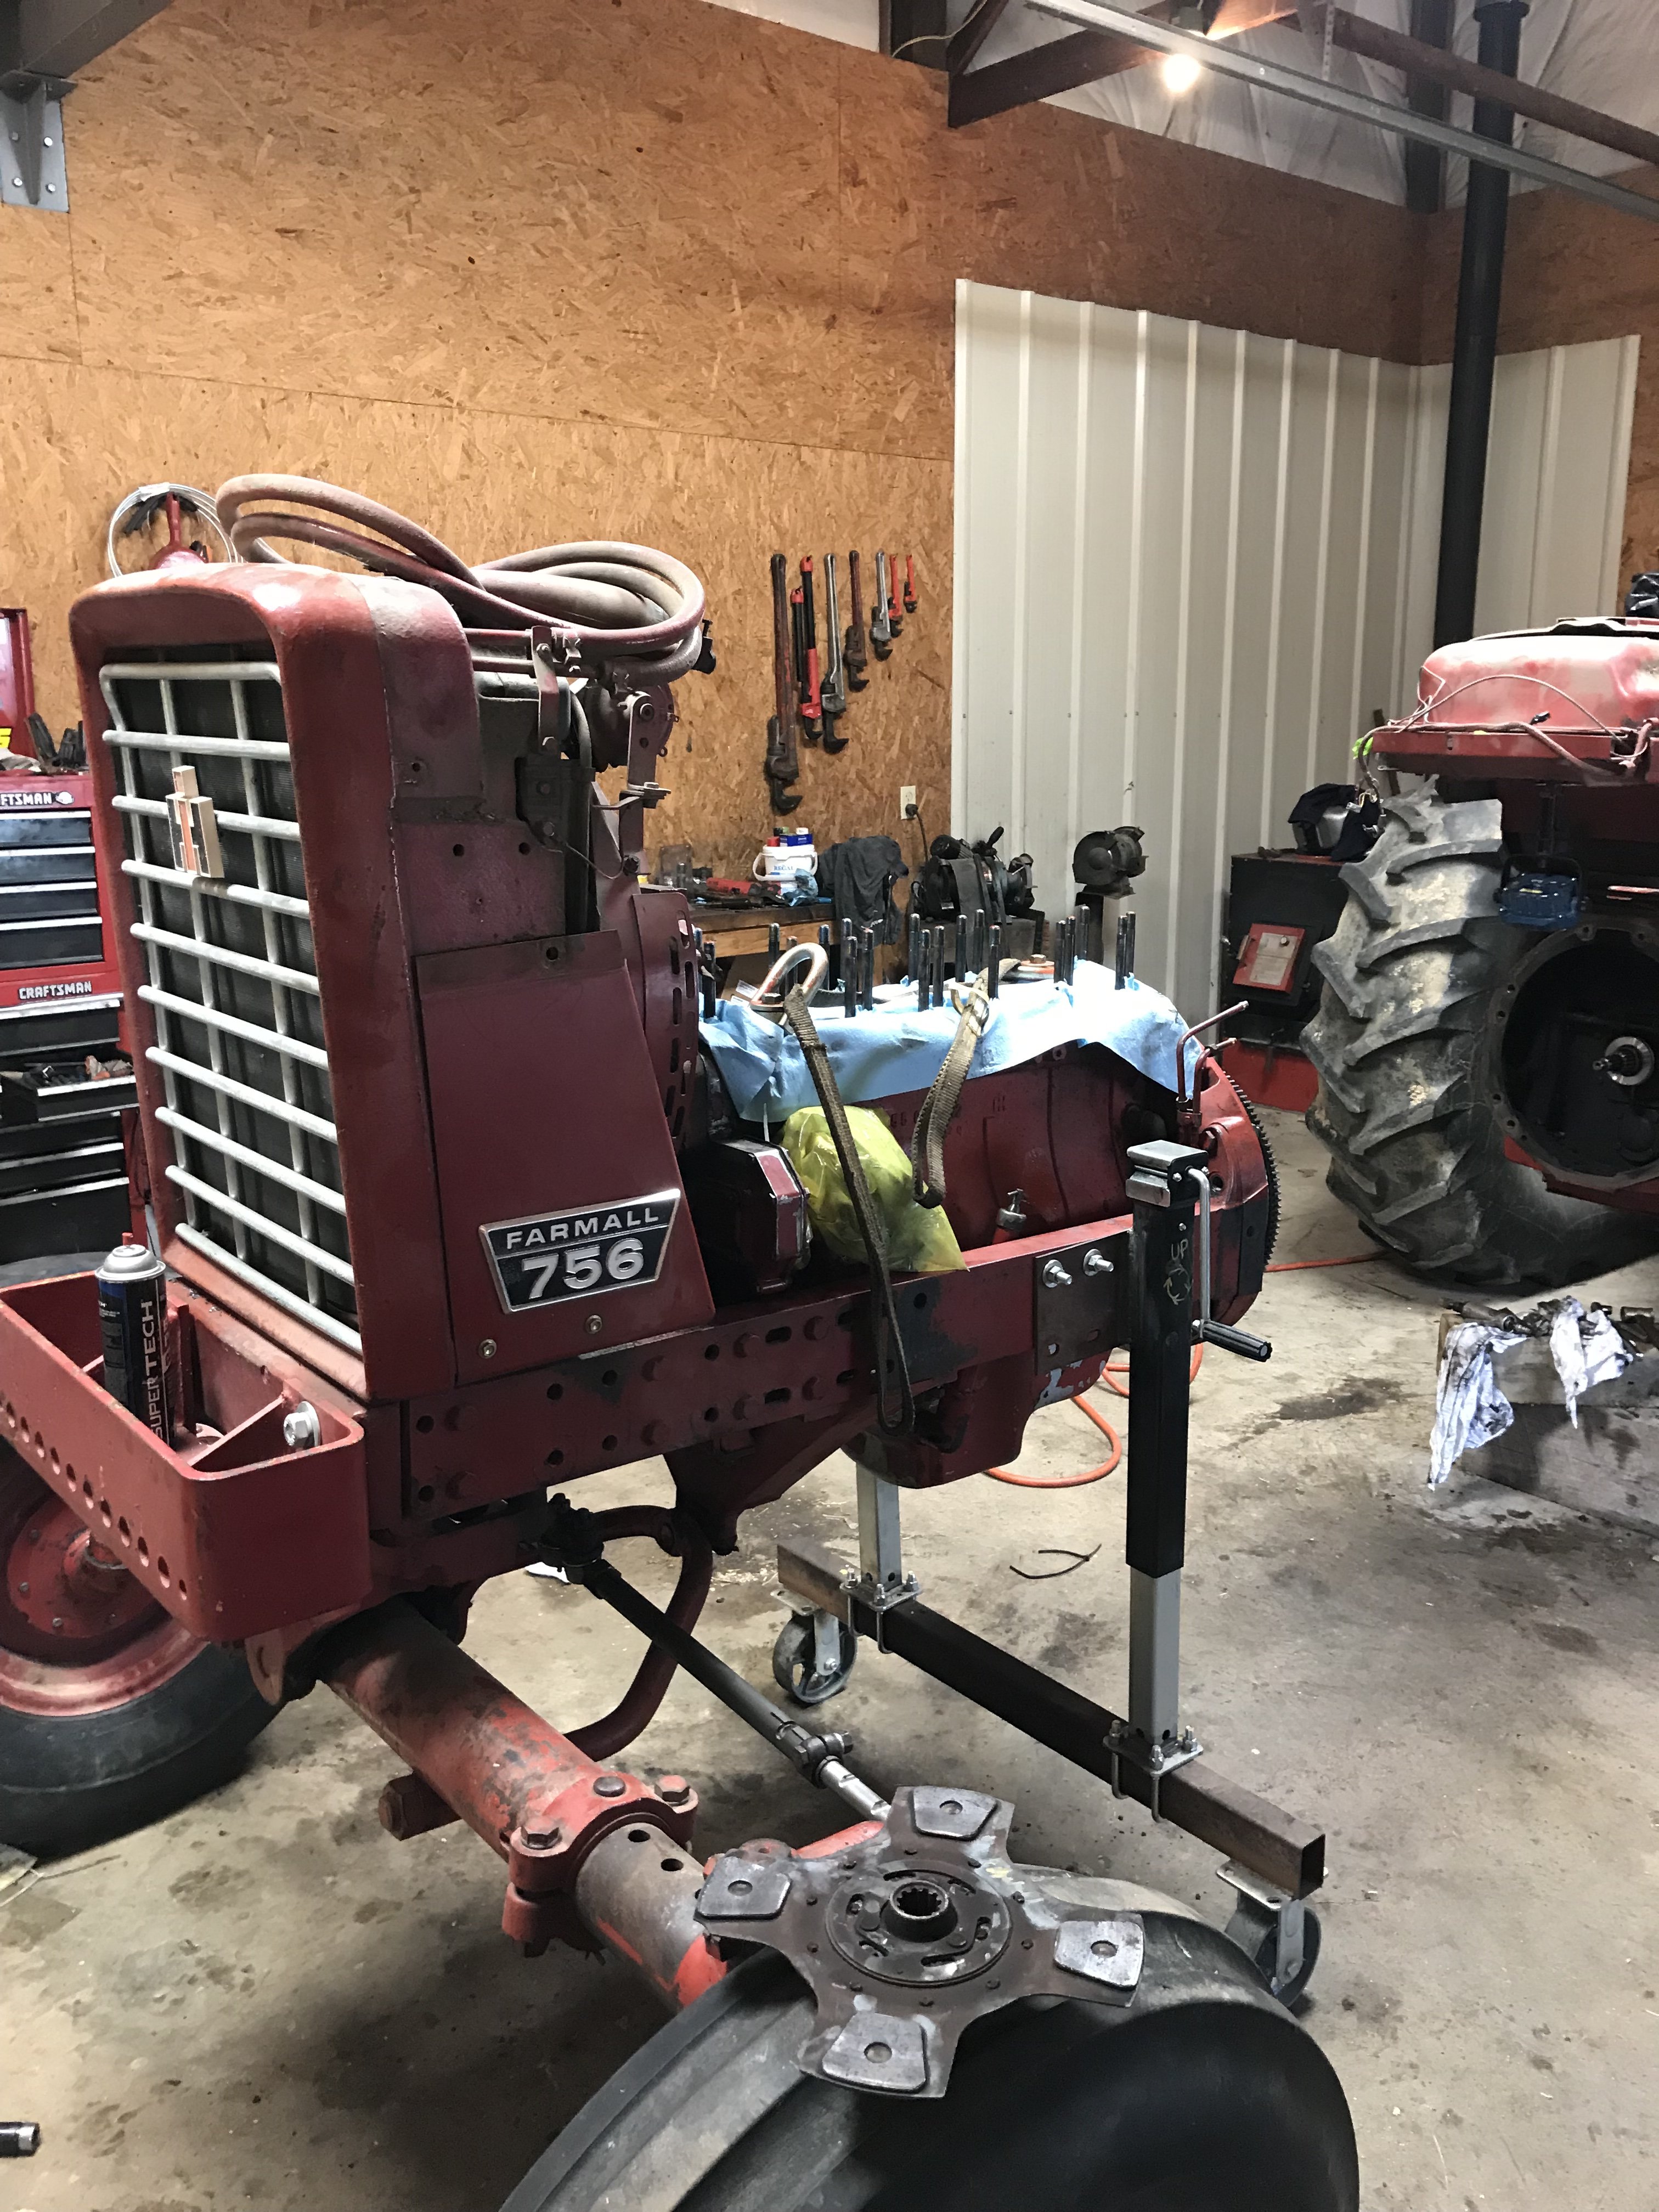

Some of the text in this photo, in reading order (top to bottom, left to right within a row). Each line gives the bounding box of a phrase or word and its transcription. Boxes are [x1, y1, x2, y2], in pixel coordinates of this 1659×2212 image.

[0, 792, 53, 806] FTSMAN
[18, 981, 92, 1000] CRAFTSMAN
[506, 1207, 659, 1250] FARMALL
[1170, 1238, 1189, 1260] UP
[521, 1238, 644, 1300] 756
